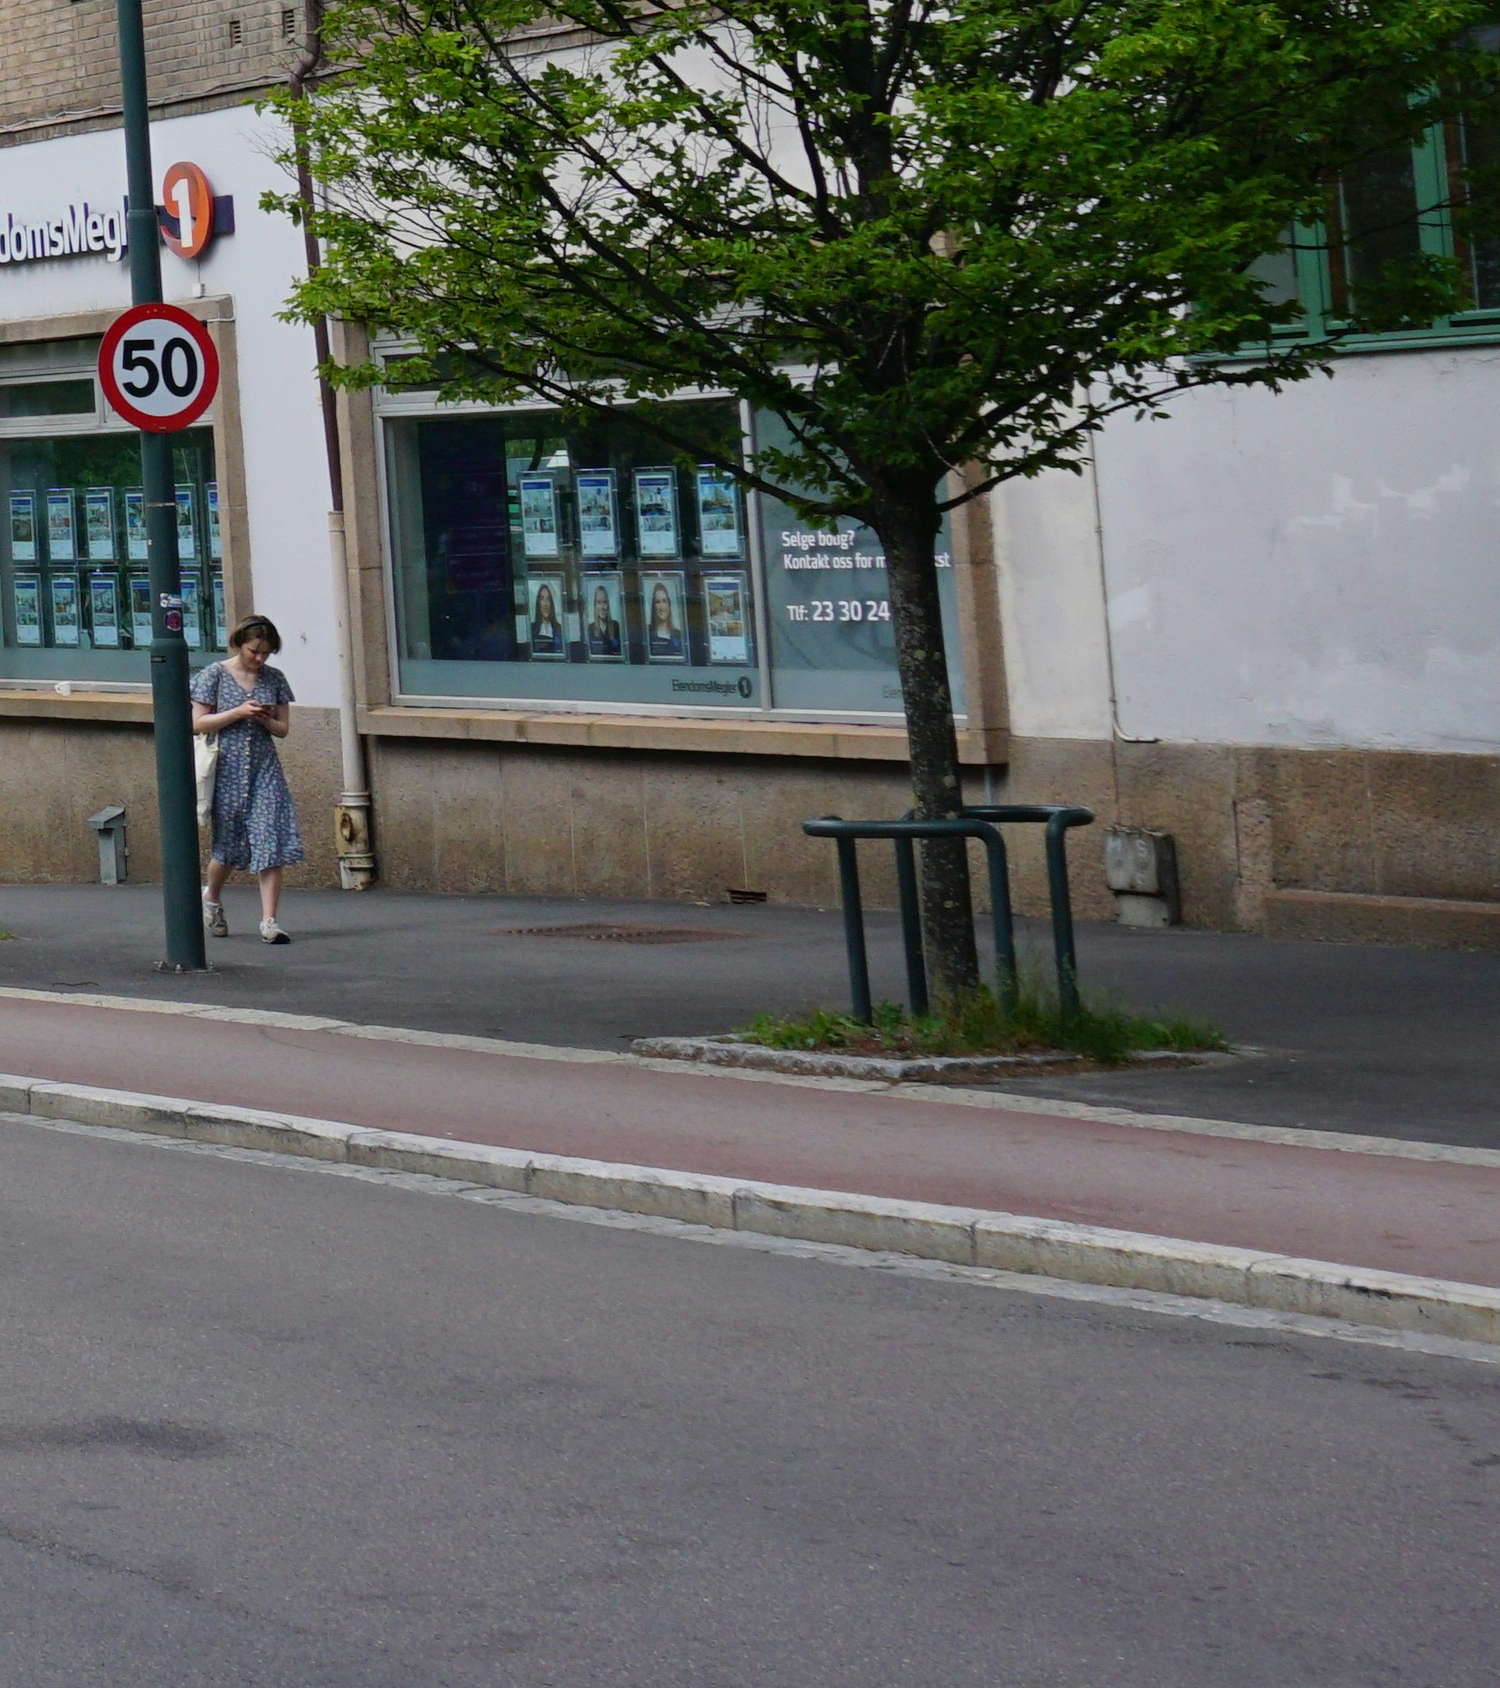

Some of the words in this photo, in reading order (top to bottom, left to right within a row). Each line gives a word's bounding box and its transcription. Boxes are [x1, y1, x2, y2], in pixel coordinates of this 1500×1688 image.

[171, 178, 194, 248] 1
[122, 337, 198, 398] 50
[782, 531, 816, 551] Selge
[784, 553, 831, 570] Kontakt
[832, 556, 853, 569] oss
[854, 553, 874, 569] for
[787, 605, 809, 621] Tlf:
[811, 600, 835, 622] 23
[838, 600, 863, 622] 30
[866, 600, 891, 622] 24
